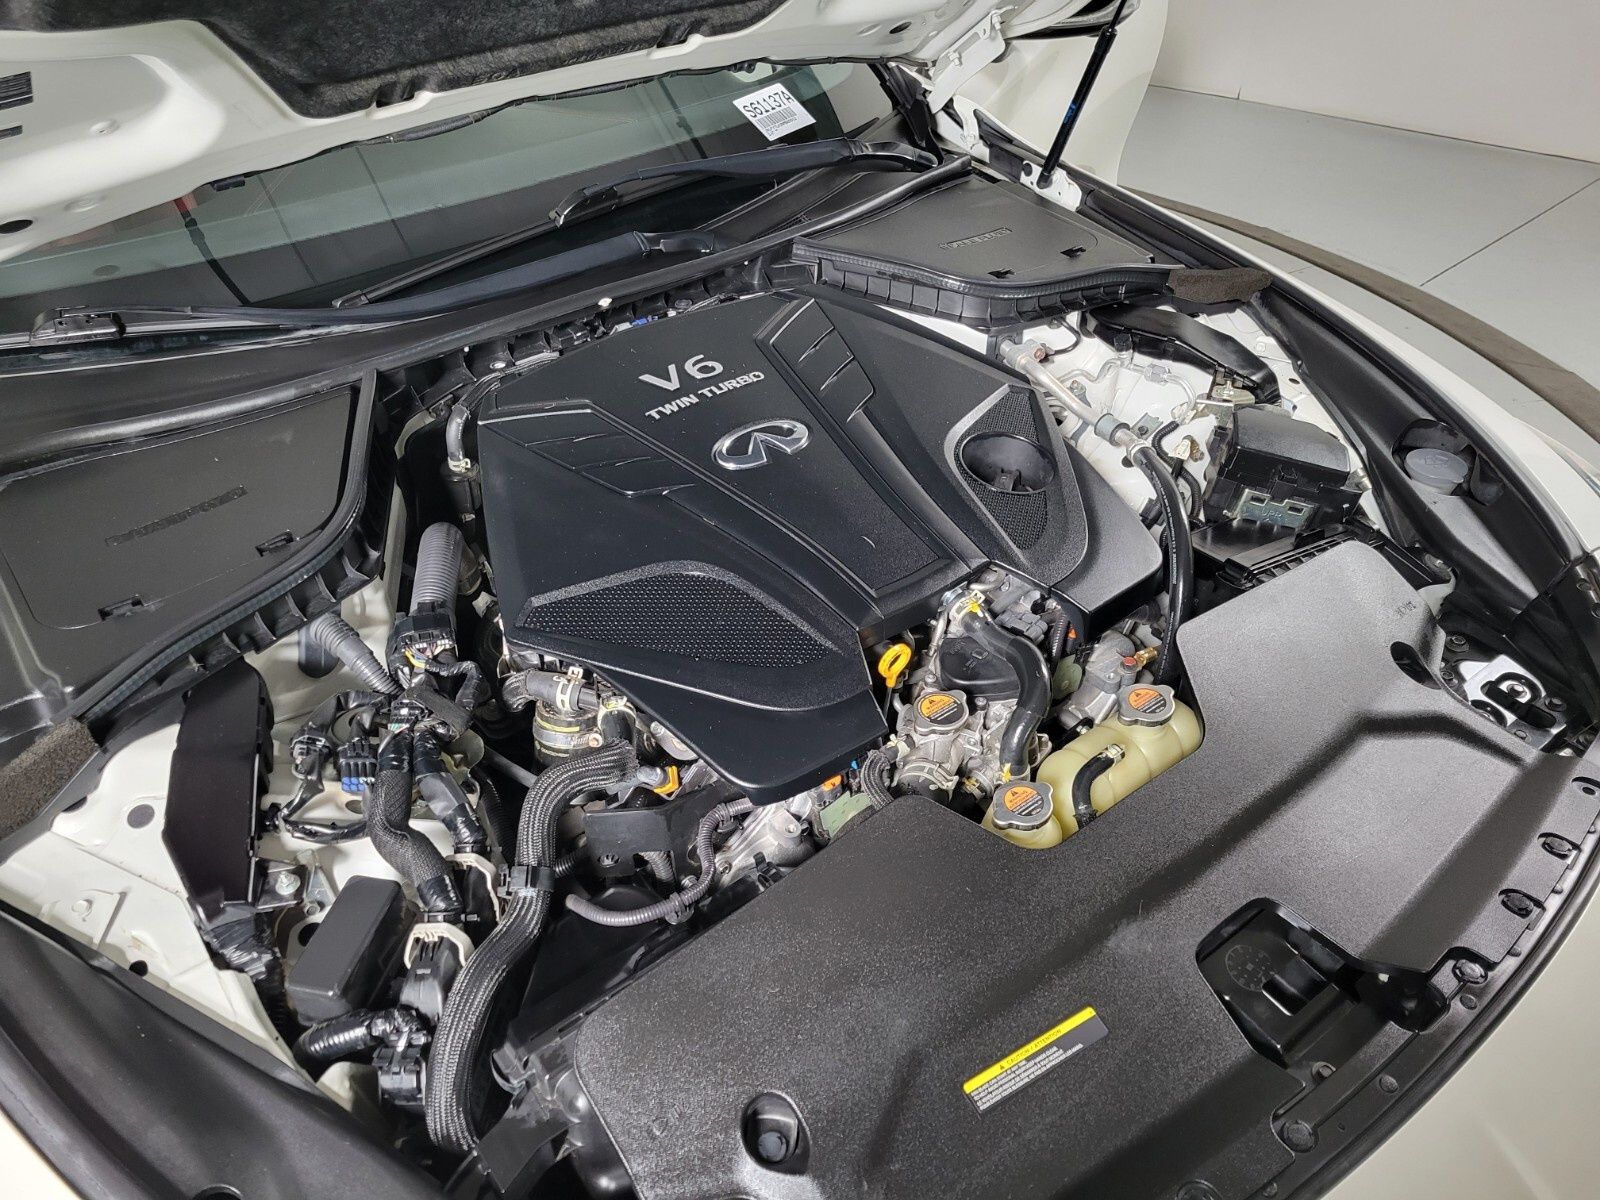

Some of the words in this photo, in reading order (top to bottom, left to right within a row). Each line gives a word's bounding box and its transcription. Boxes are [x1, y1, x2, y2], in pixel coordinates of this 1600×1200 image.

[743, 90, 795, 118] S61137A
[638, 354, 724, 391] V6
[645, 393, 699, 420] TWIN
[698, 371, 765, 398] TURBO
